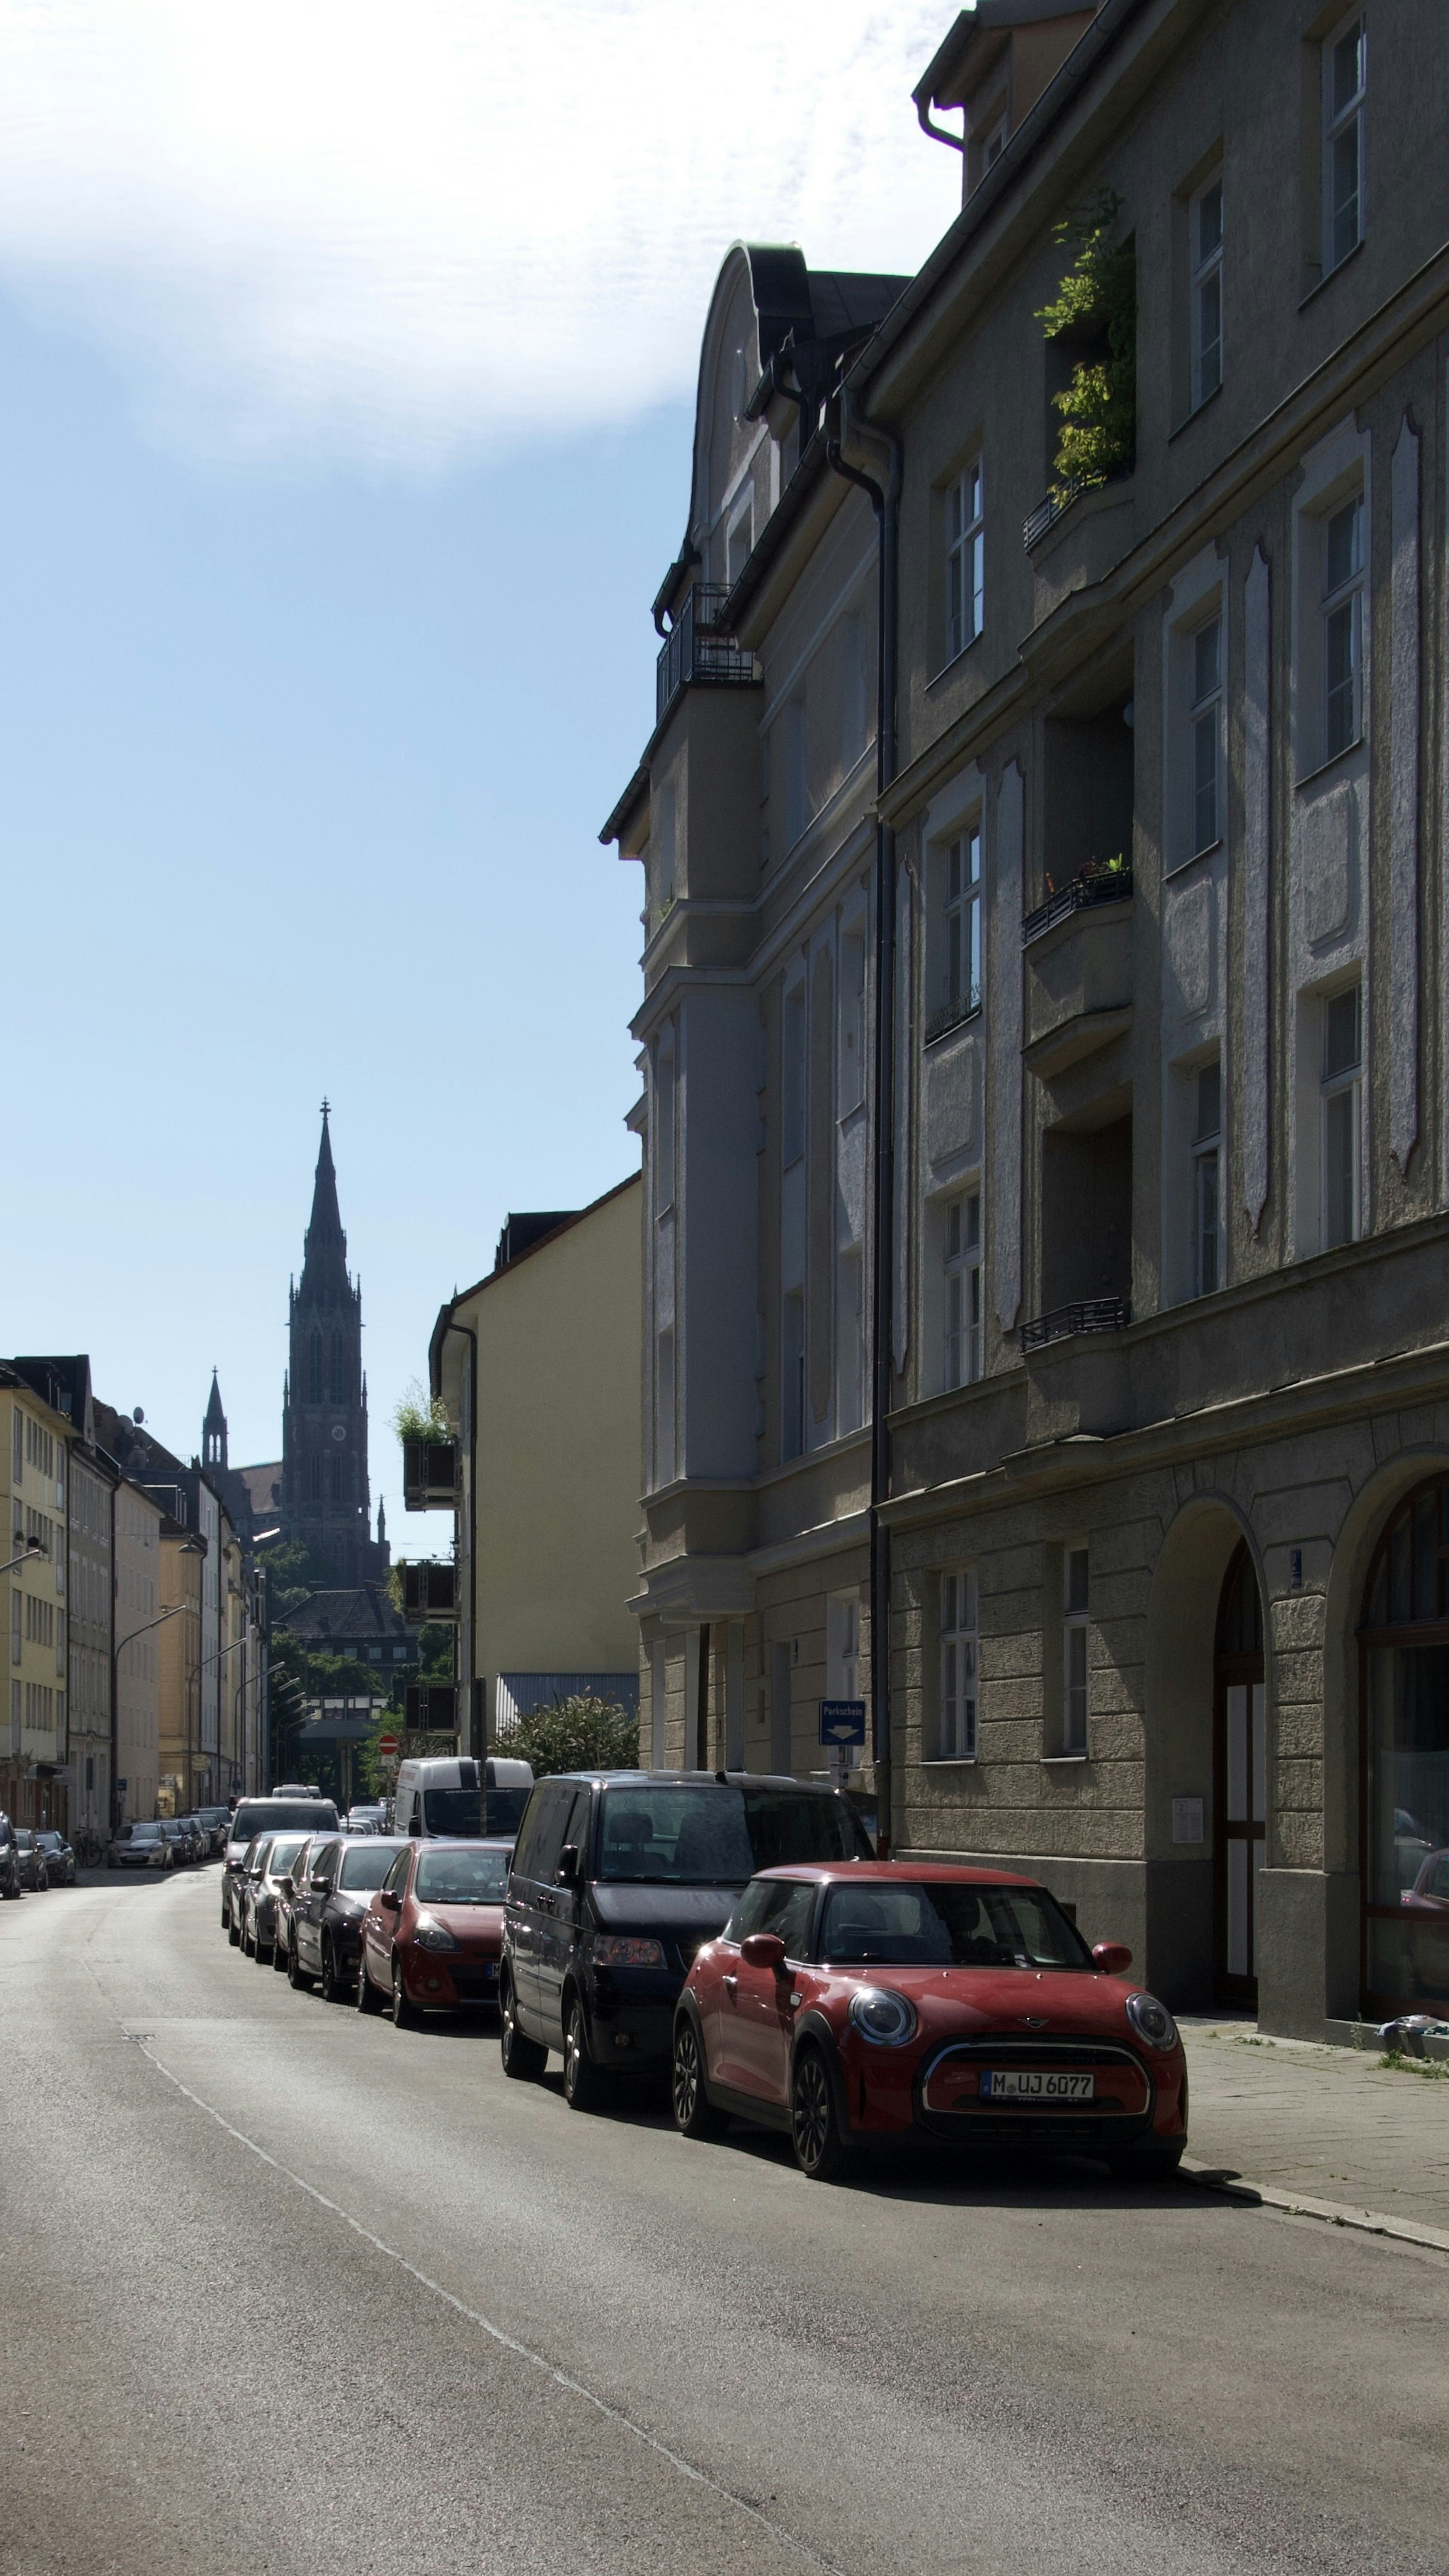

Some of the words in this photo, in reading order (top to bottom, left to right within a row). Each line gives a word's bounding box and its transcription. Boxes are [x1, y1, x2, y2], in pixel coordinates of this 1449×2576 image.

[824, 1706, 863, 1716] Parkschein
[994, 2075, 1006, 2092] M
[1046, 2077, 1091, 2095] 6077
